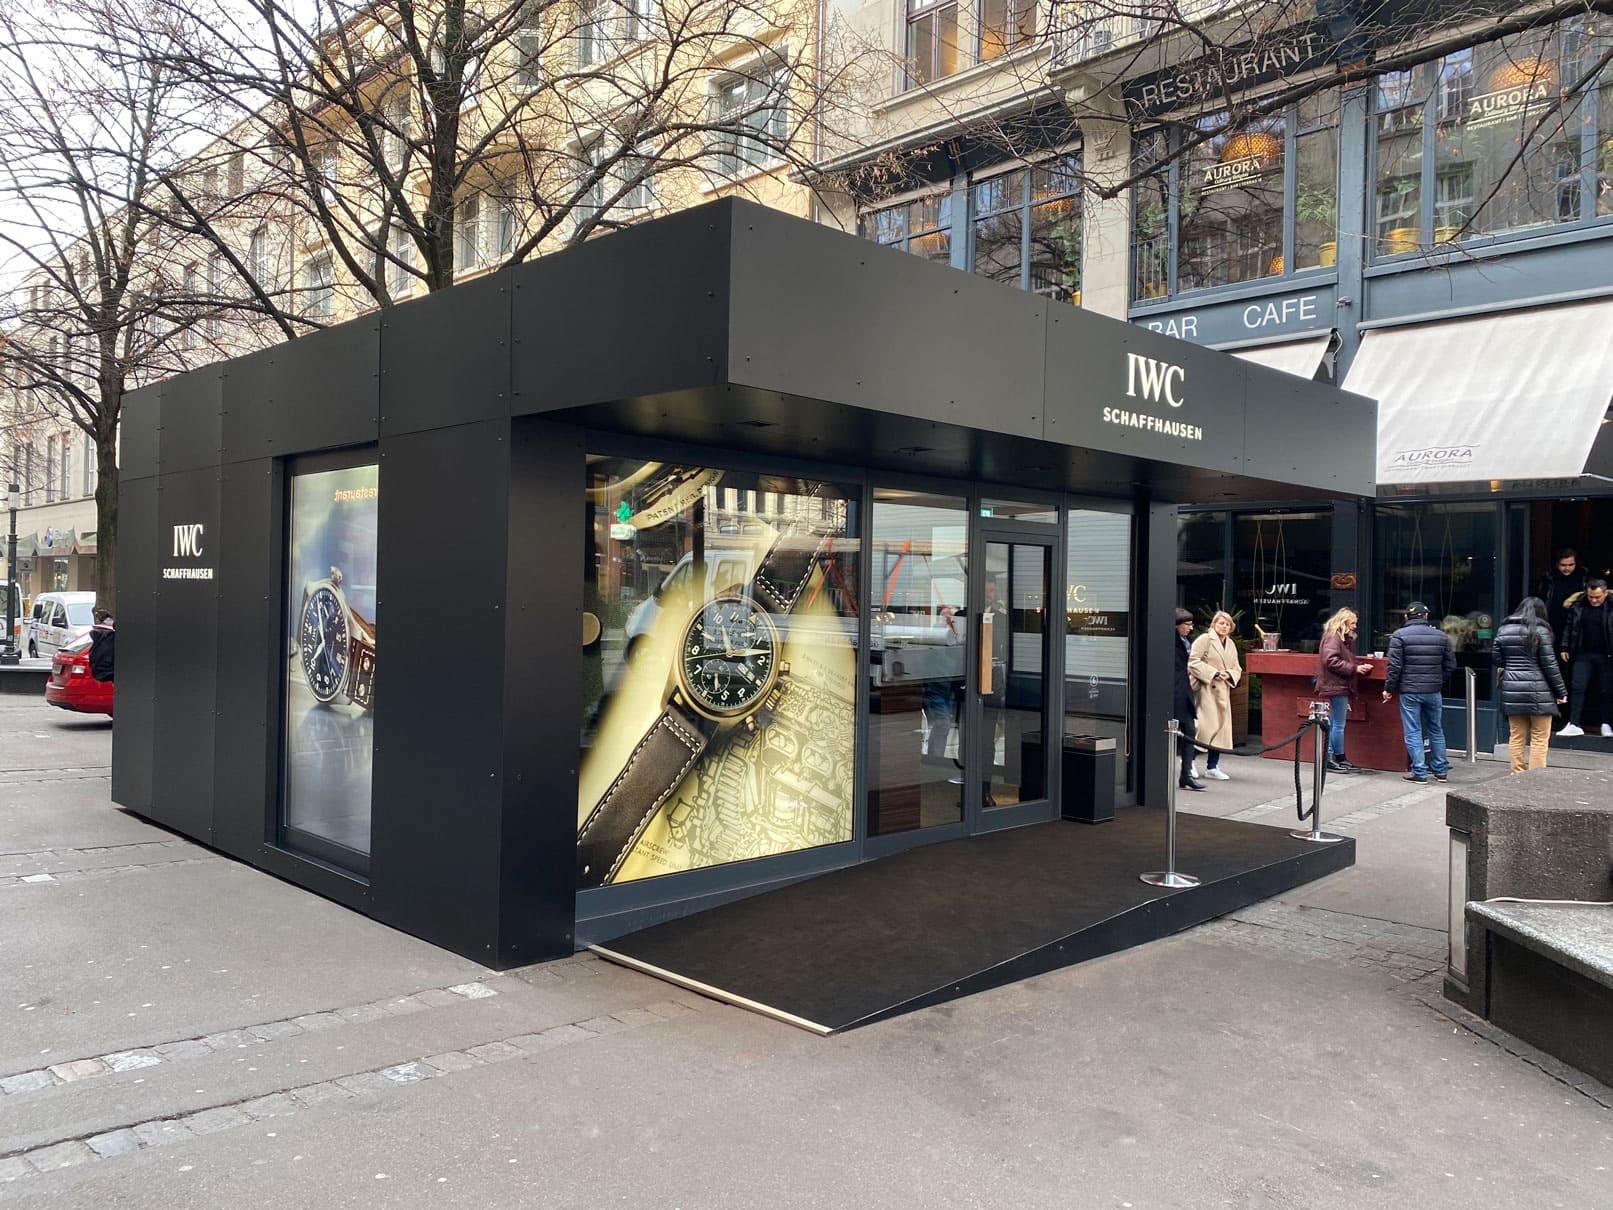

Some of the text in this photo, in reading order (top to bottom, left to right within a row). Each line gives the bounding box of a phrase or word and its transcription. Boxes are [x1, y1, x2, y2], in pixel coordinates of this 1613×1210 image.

[1470, 85, 1548, 115] AURORA
[1204, 160, 1261, 182] AURORA
[1243, 295, 1317, 328] CAFE
[1126, 353, 1185, 407] IWC
[1103, 407, 1202, 440] SCHAFFHAUSEN
[1393, 449, 1473, 463] AURORA
[173, 524, 203, 557] IWC
[163, 568, 213, 579] SCHAFFHAUSEN
[713, 613, 723, 624] 10
[692, 645, 700, 655] 8
[757, 656, 766, 666] 2
[694, 665, 703, 675] 7
[721, 690, 730, 700] 5
[737, 688, 746, 698] 4
